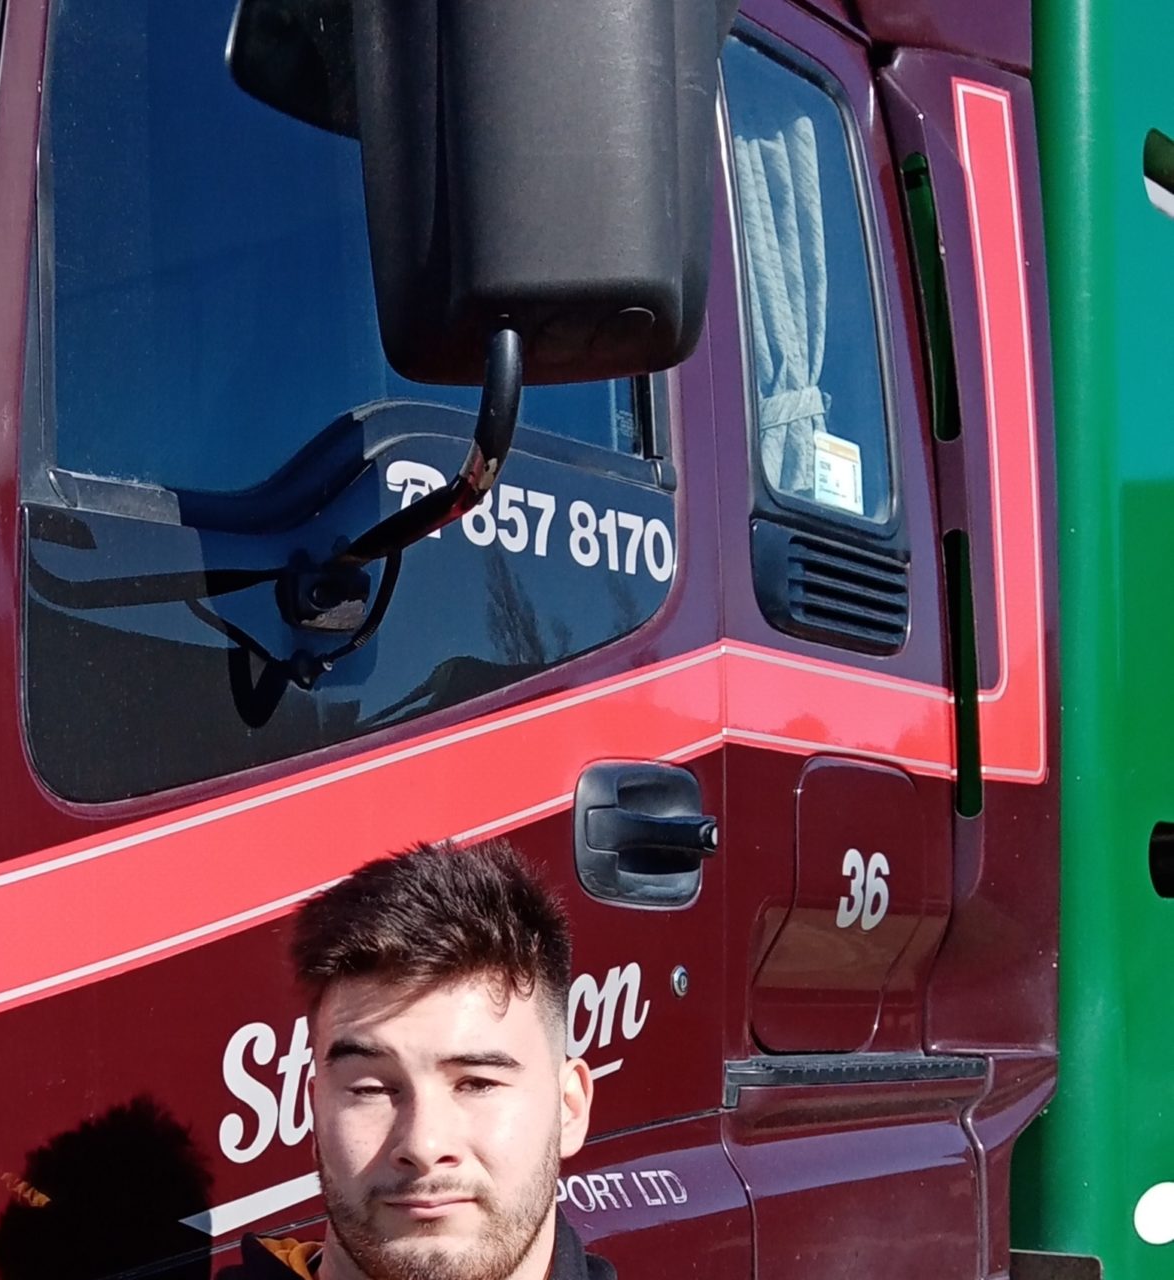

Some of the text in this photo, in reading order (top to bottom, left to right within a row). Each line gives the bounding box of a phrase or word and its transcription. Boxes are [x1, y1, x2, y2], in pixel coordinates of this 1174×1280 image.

[461, 483, 673, 582] 857 8170
[836, 848, 890, 930] 36
[630, 1169, 687, 1206] LTD
